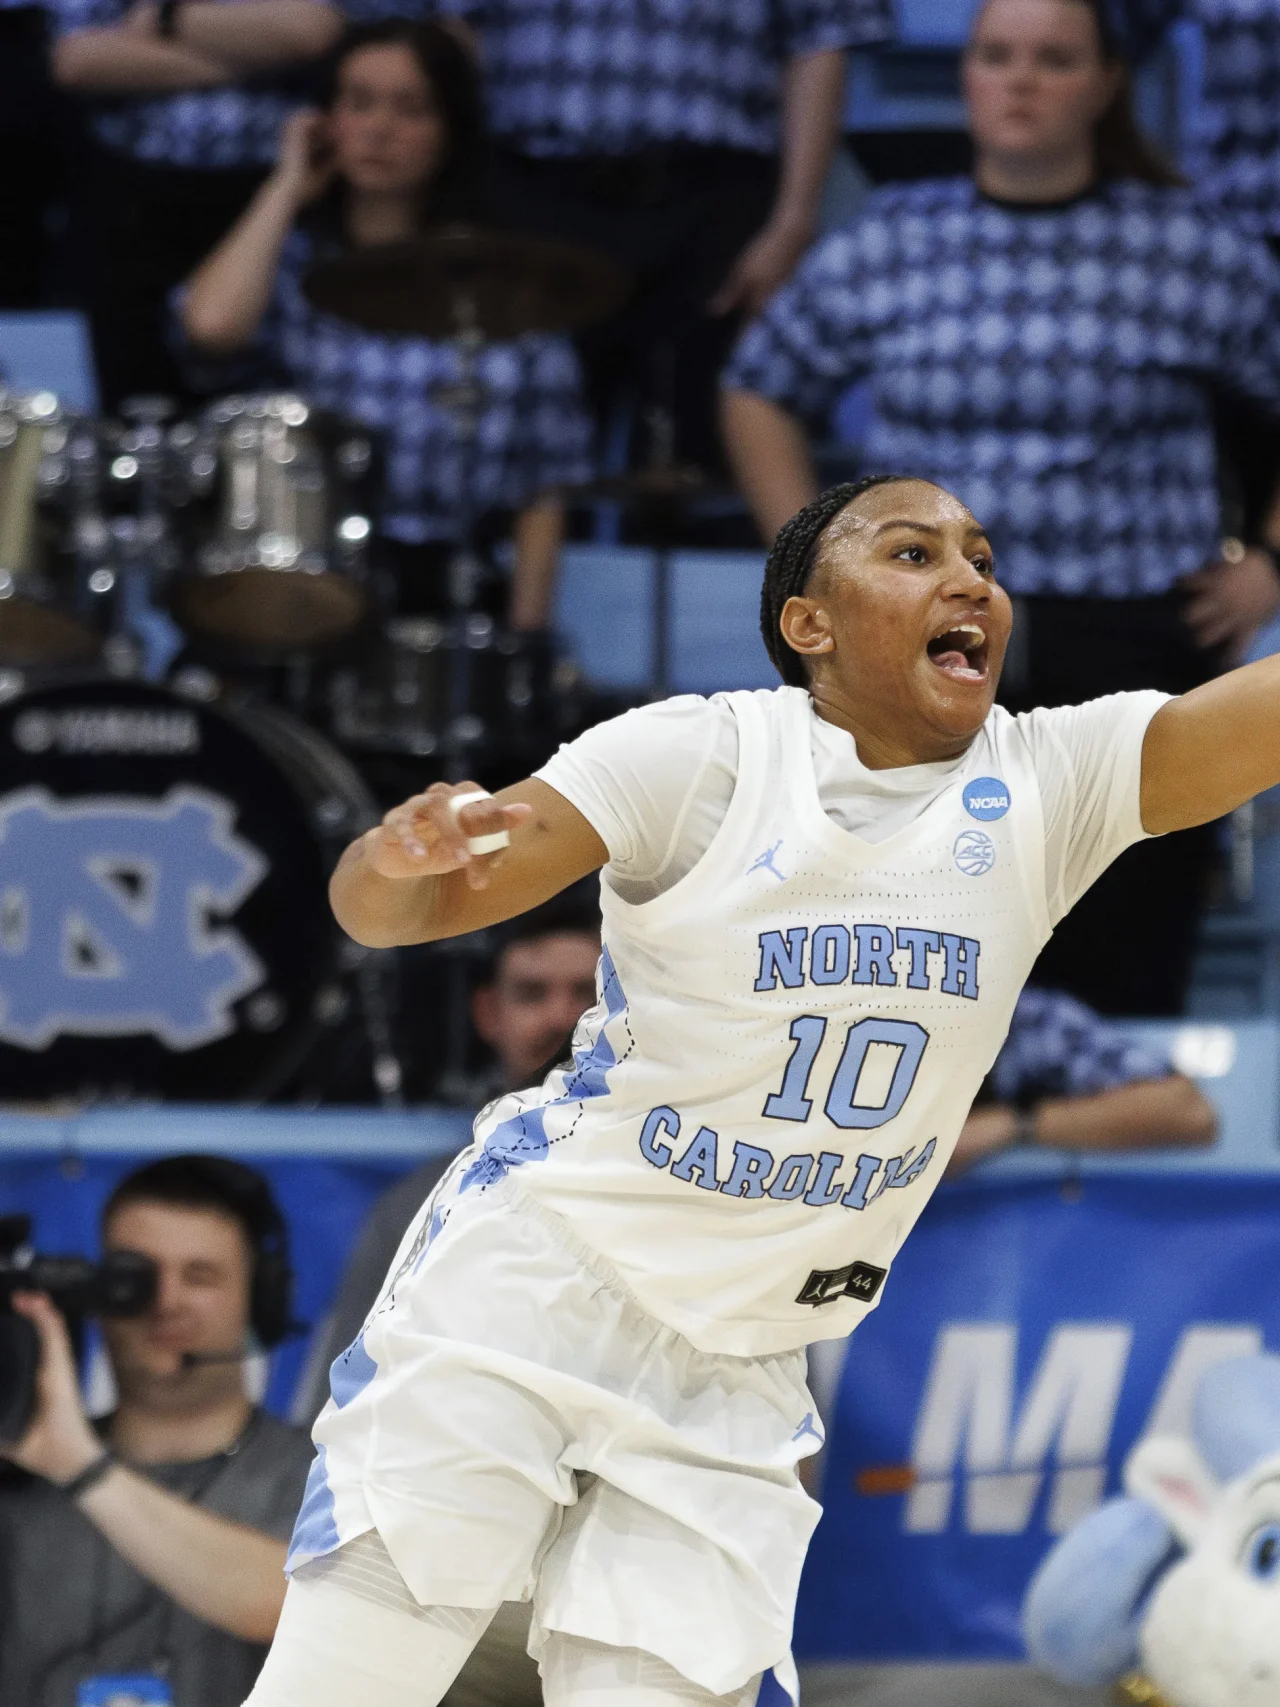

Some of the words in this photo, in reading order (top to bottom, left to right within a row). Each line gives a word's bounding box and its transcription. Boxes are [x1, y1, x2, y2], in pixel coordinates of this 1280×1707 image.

[969, 796, 1008, 810] NCAA
[954, 845, 993, 859] ACC
[754, 924, 981, 1001] NORTH
[762, 1014, 930, 1130] 10
[852, 1274, 872, 1290] 44
